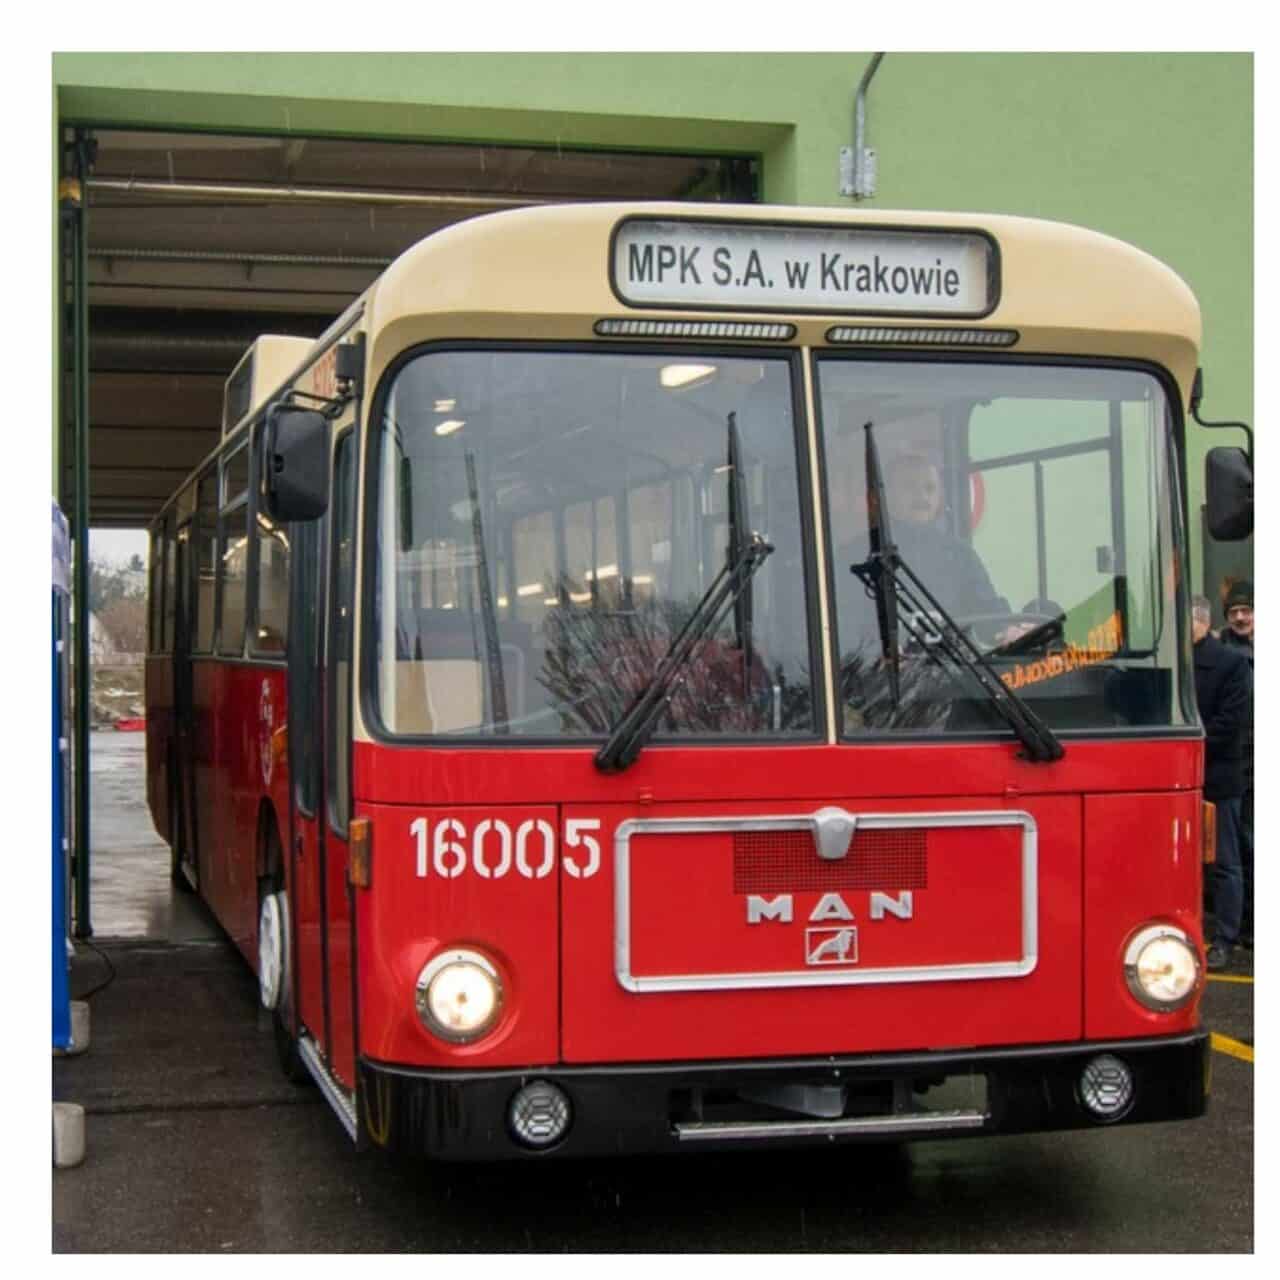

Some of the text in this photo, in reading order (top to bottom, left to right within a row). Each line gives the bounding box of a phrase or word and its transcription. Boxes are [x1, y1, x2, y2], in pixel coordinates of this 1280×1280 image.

[628, 243, 960, 297] MPK S.A. w Krakowie
[410, 817, 601, 879] 16005
[747, 890, 913, 924] MAN
